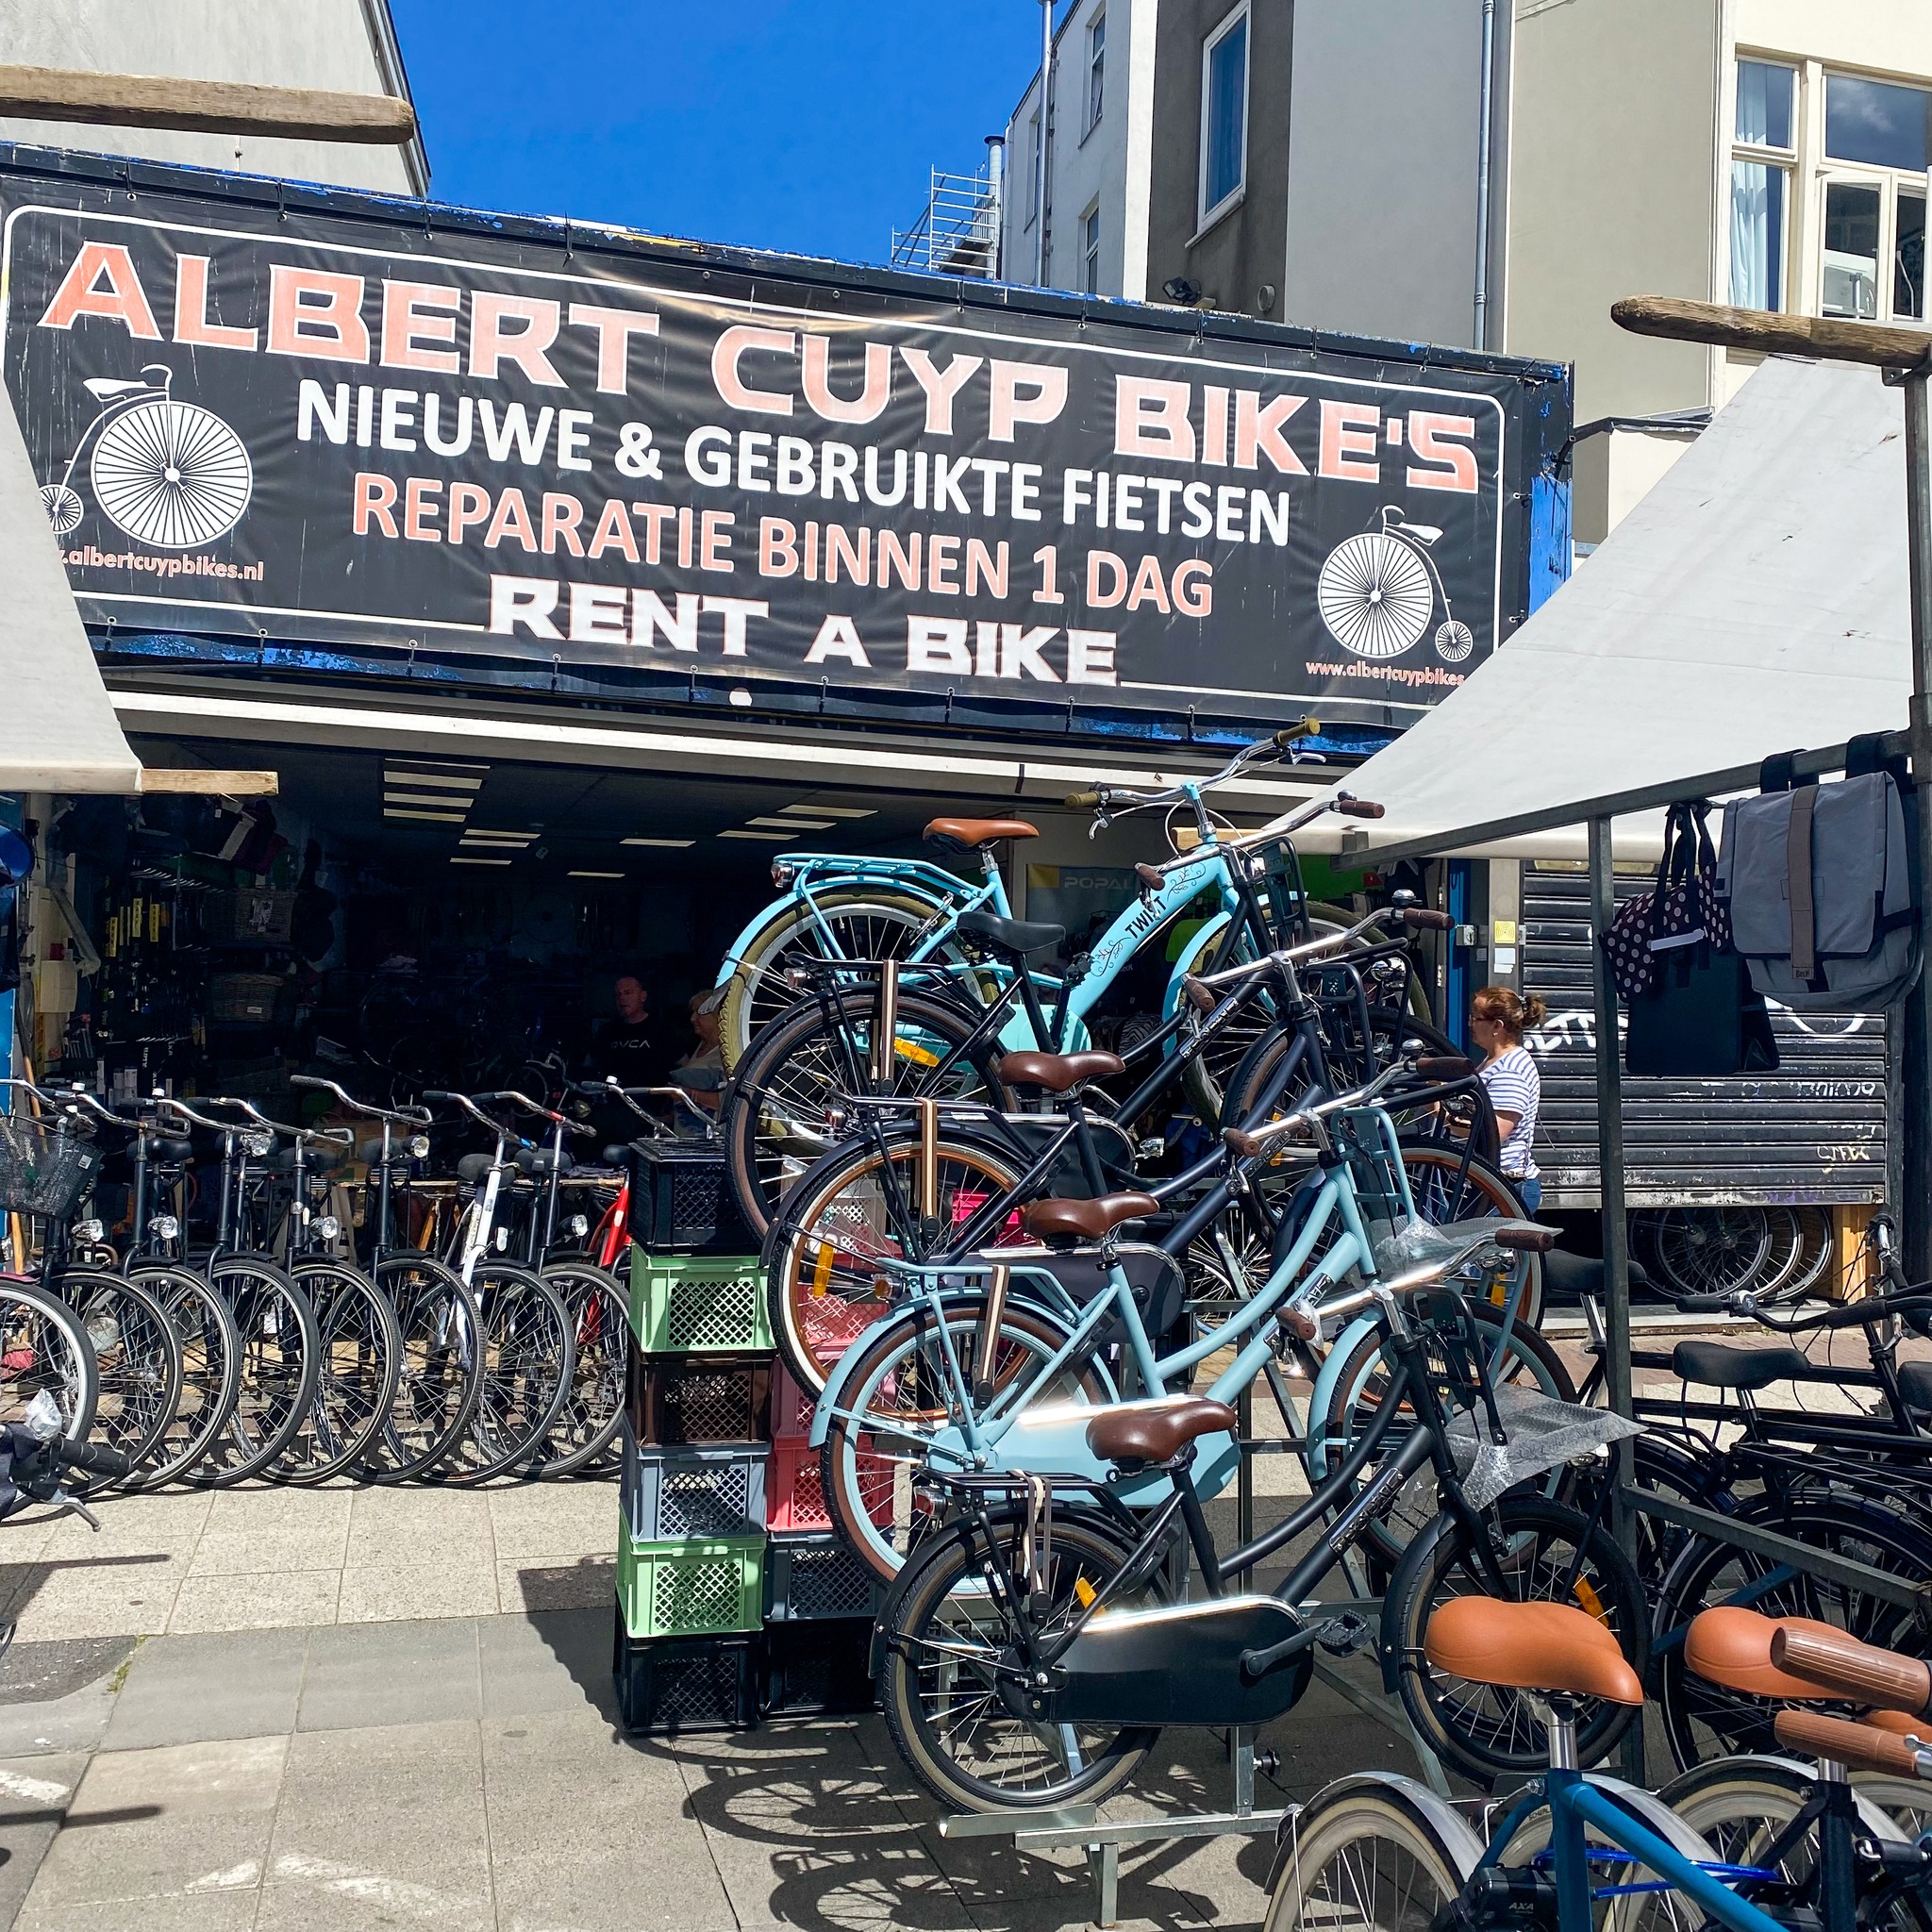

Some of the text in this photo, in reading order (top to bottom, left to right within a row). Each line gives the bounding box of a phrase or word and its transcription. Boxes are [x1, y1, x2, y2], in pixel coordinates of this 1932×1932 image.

[36, 240, 1479, 494] ALBERT CUYP BIKE'S
[297, 378, 1291, 547] NIEUWE & GEBRUIKTE FIETSEN
[352, 472, 1214, 618] REPARATIE BINNEN 1 DAG
[489, 573, 1120, 688] RENT A BIKE
[1064, 876, 1132, 890] POPAL
[1508, 1902, 1534, 1910] AXA
